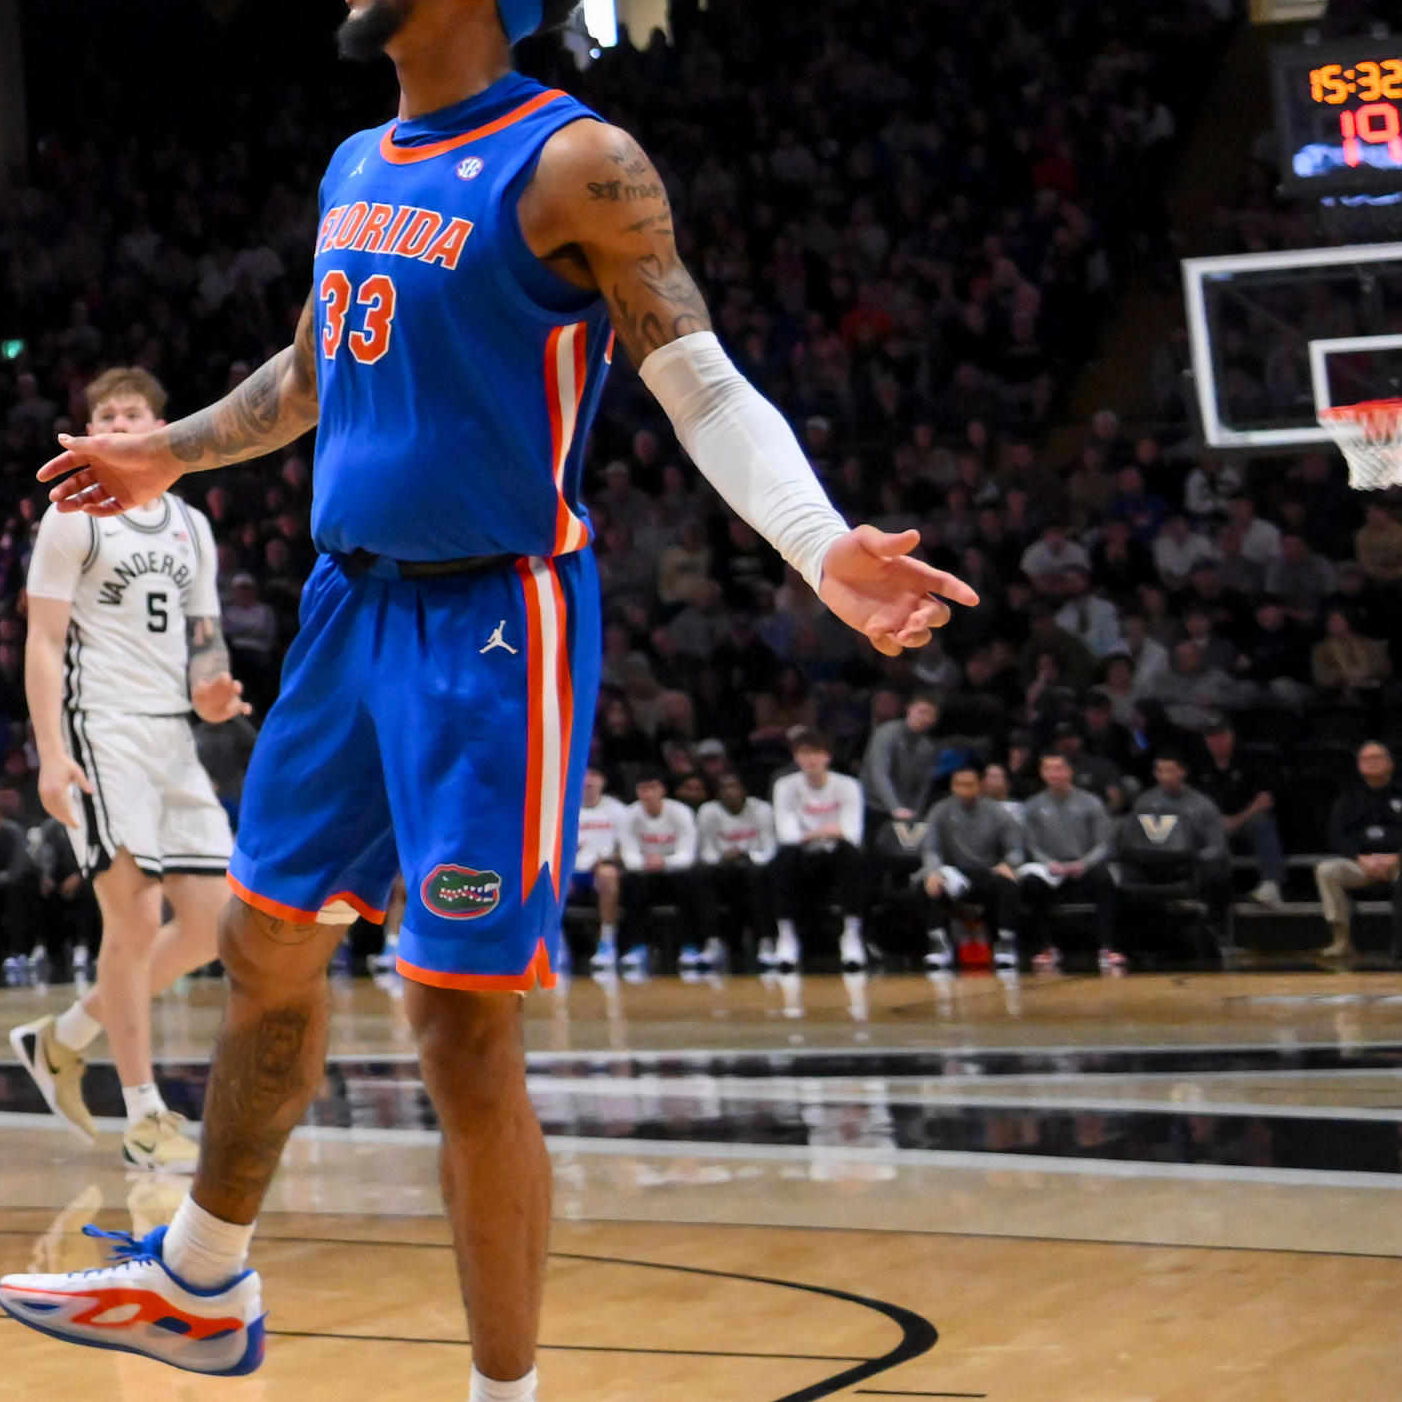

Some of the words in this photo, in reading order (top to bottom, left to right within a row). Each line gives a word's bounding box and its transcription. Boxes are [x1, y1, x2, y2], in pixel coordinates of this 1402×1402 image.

[314, 200, 474, 271] FLORIDA
[320, 269, 396, 365] 33
[146, 591, 168, 633] 5
[1137, 813, 1179, 845] V
